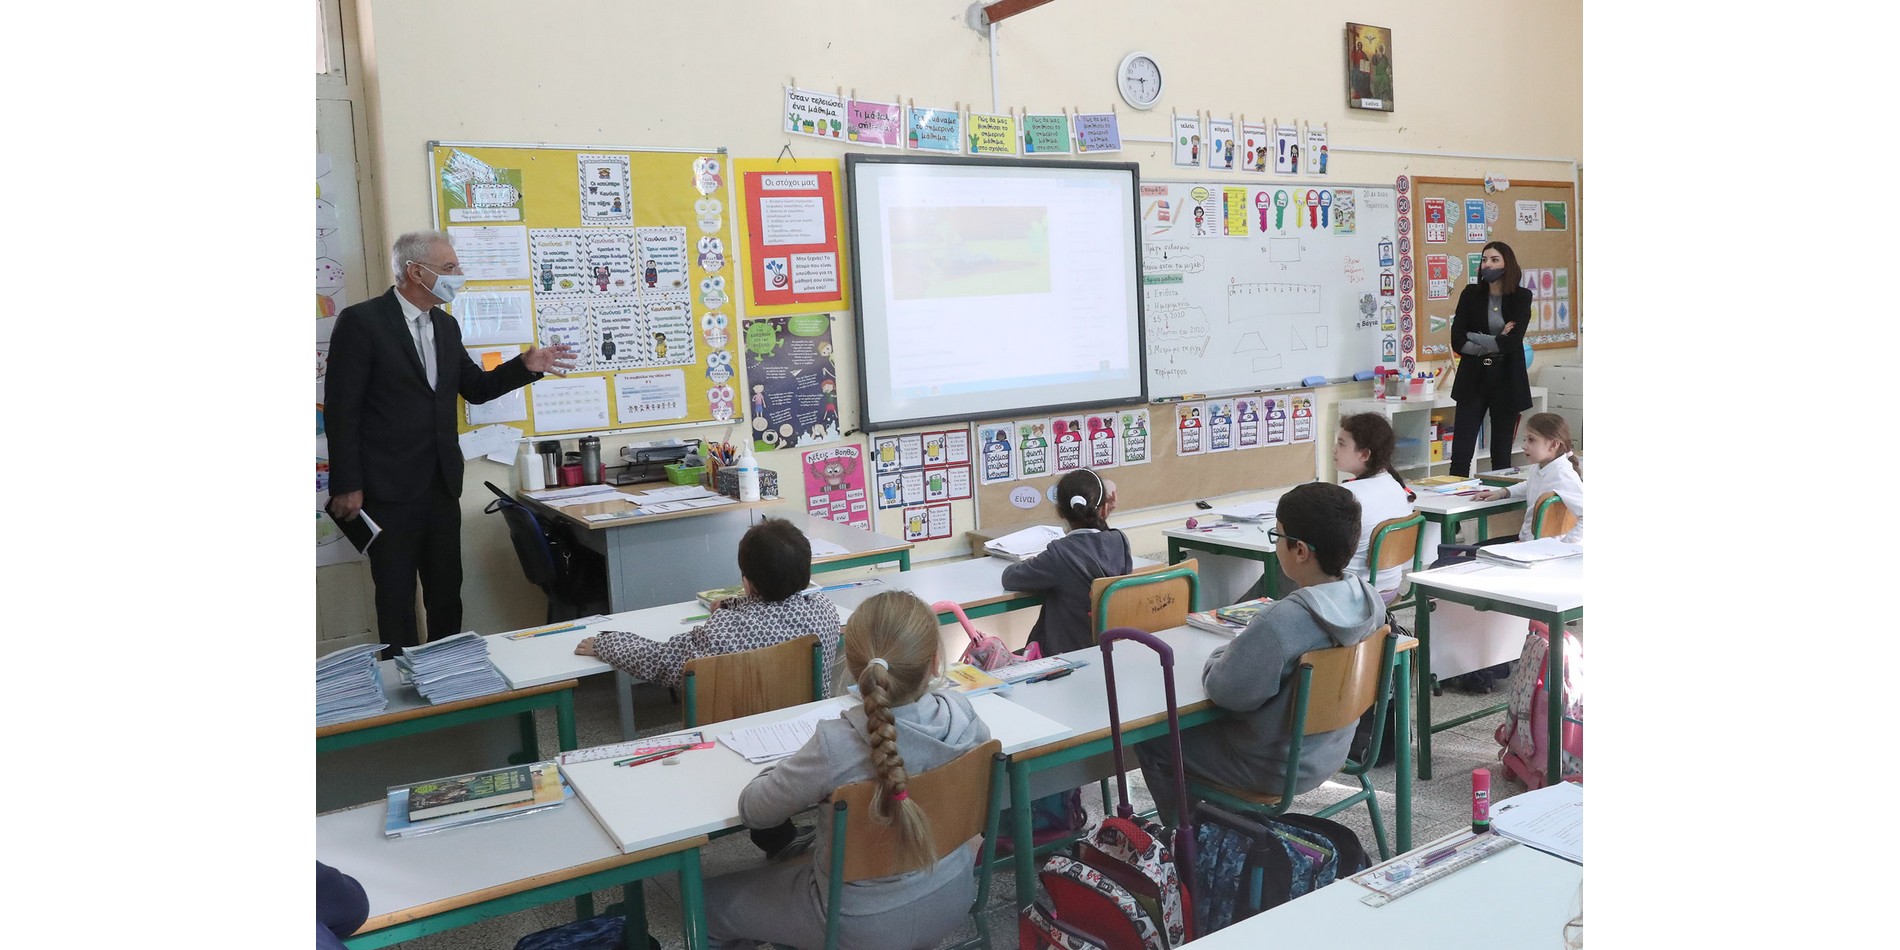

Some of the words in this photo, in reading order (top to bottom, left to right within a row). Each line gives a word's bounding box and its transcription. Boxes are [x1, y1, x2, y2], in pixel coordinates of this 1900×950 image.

[789, 92, 810, 102] Όταν
[811, 97, 844, 108] τελειώσει
[792, 103, 806, 111] ένα
[775, 178, 800, 187] στόχοι
[801, 179, 816, 187] μας
[1525, 214, 1532, 225] 32
[1170, 311, 1185, 319] 2020
[1362, 320, 1378, 328] Βάγια
[1190, 326, 1205, 334] 2020
[1154, 368, 1187, 379] περίμετρος
[1025, 449, 1043, 458] φωνή
[1060, 445, 1079, 453] δέντρο
[808, 452, 829, 463] Λέξεις
[1014, 493, 1036, 504] είναι
